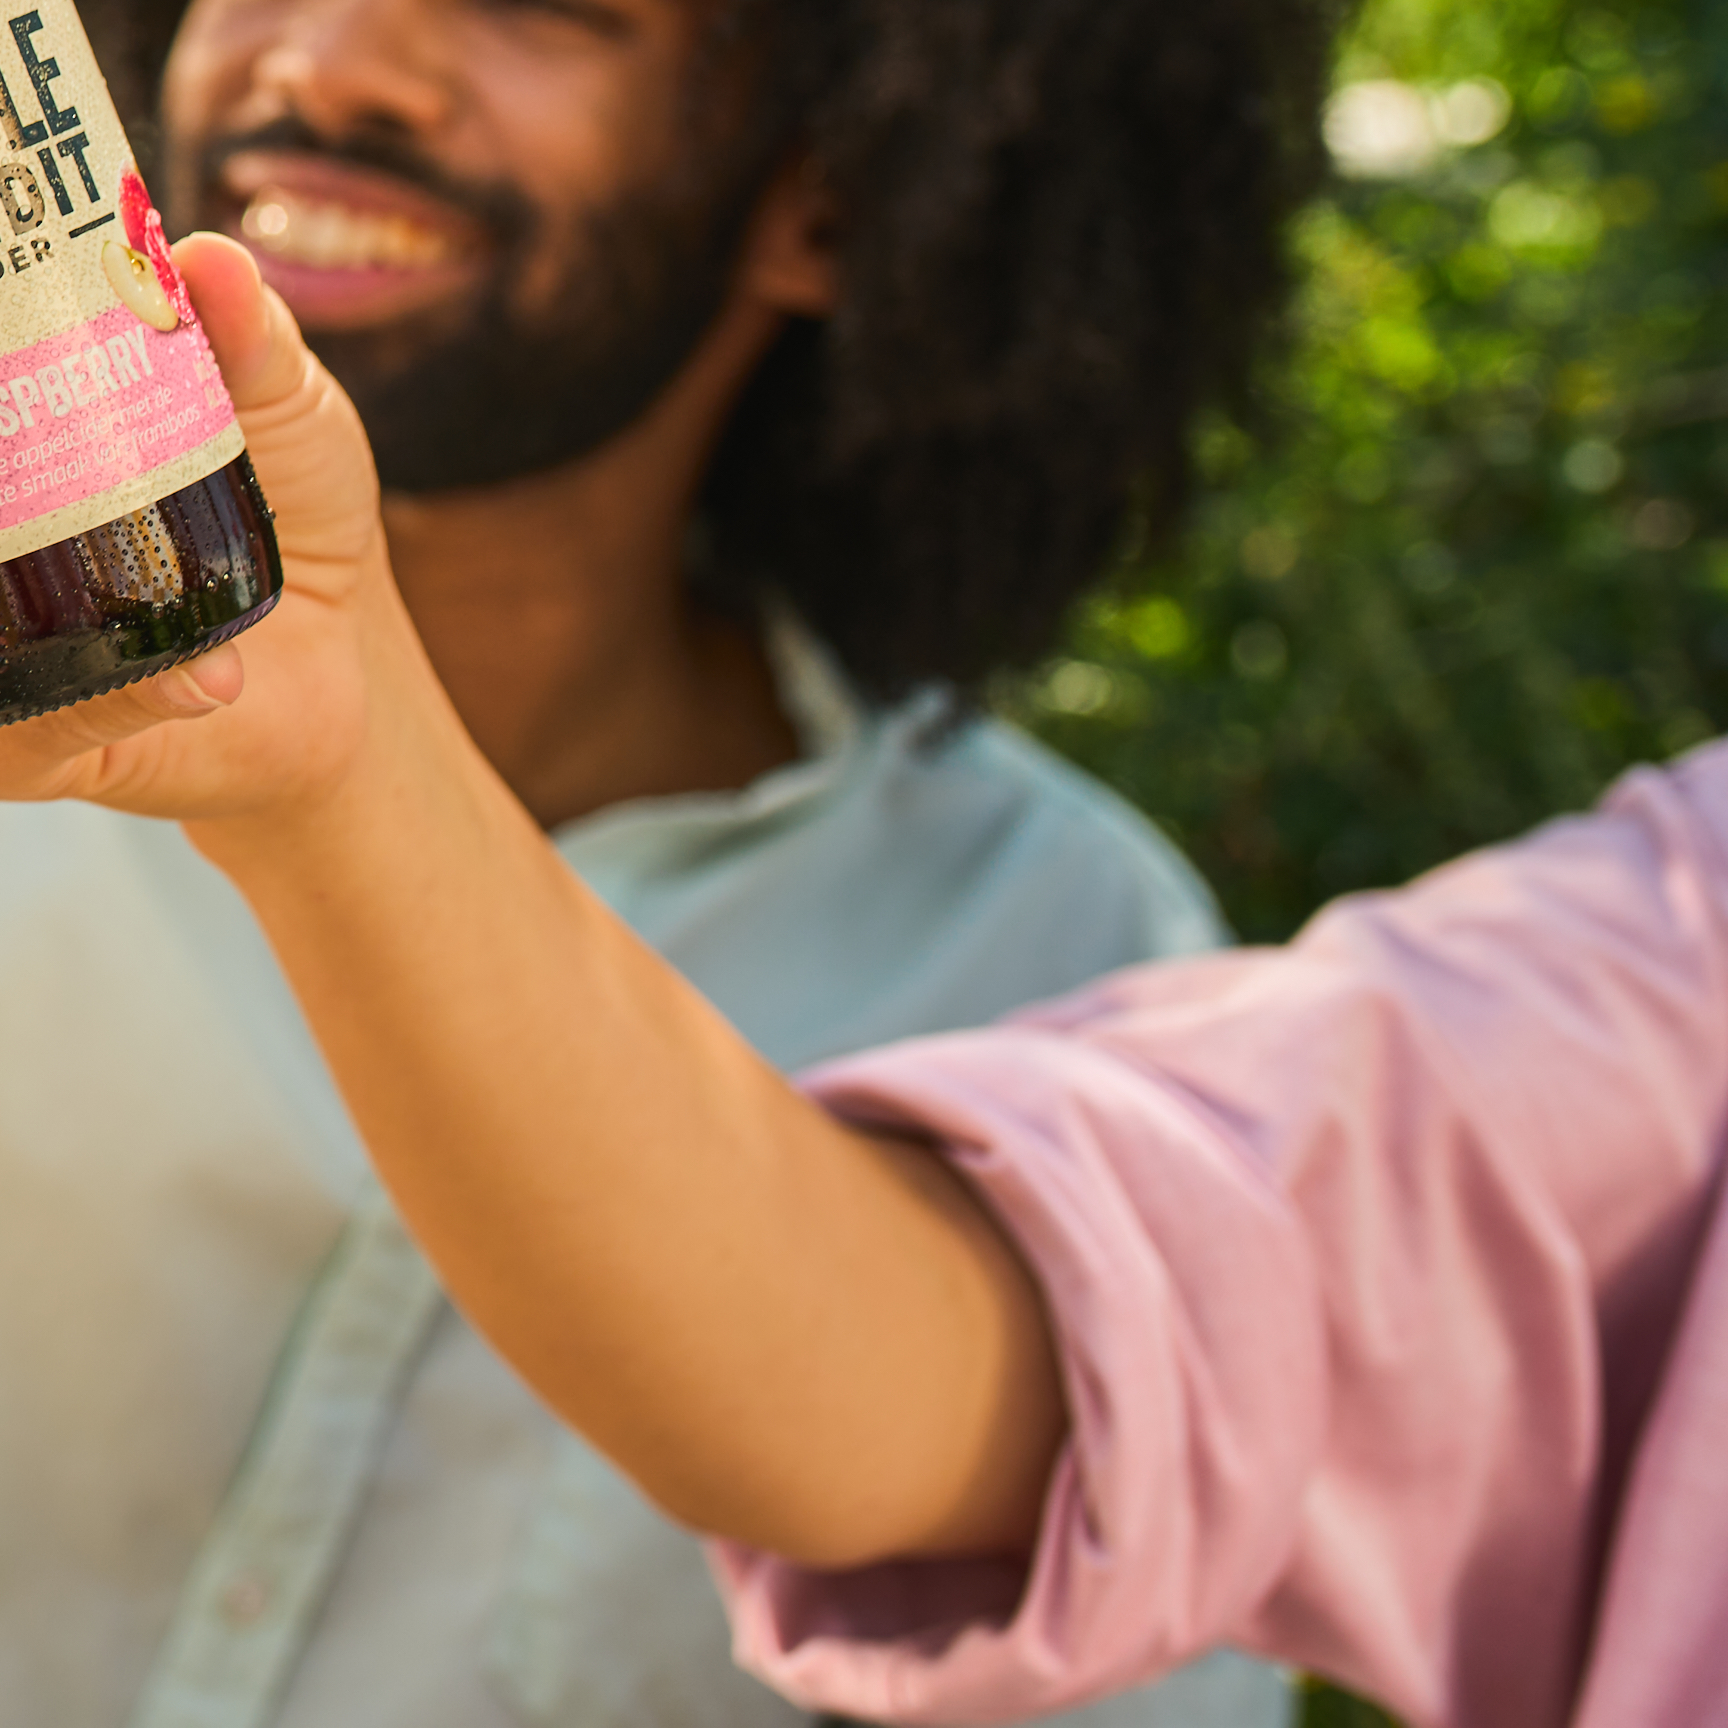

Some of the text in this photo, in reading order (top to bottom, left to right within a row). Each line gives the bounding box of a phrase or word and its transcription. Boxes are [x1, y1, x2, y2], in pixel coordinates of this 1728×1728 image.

[13, 412, 115, 470] appelcider
[118, 395, 153, 425] met
[154, 384, 173, 408] de
[131, 405, 200, 456] framboos
